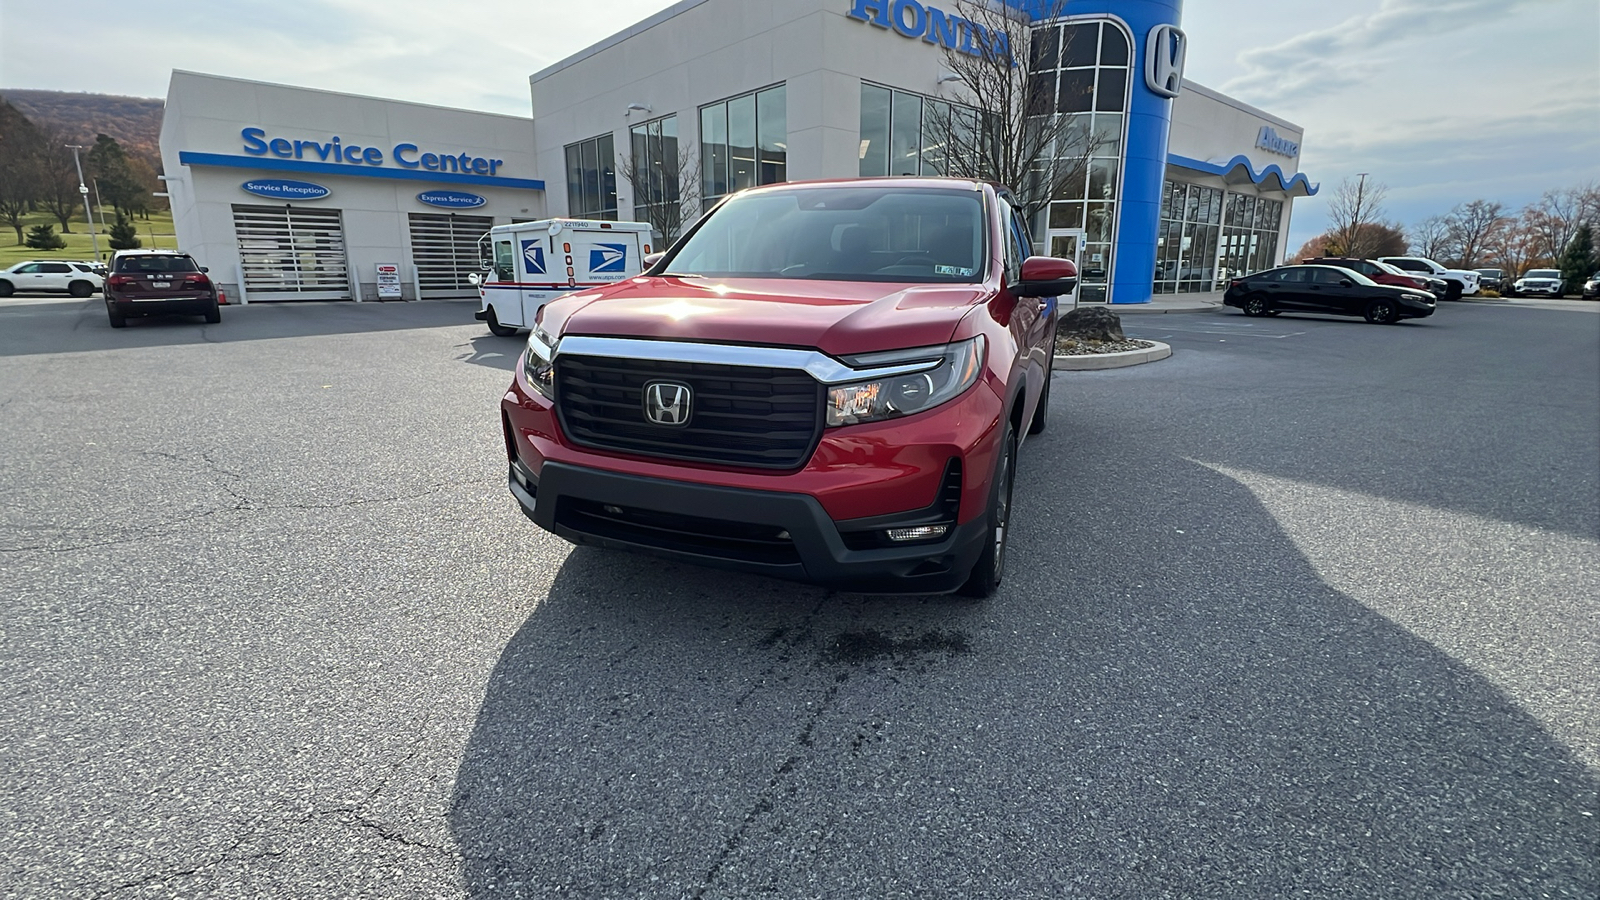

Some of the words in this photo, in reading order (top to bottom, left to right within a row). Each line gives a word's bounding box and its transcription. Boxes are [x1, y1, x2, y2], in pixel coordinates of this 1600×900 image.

[241, 127, 383, 166] Service
[393, 143, 503, 175] Center
[247, 183, 281, 192] Service
[282, 185, 325, 195] Reception
[421, 194, 447, 203] Express
[448, 195, 473, 203] Service
